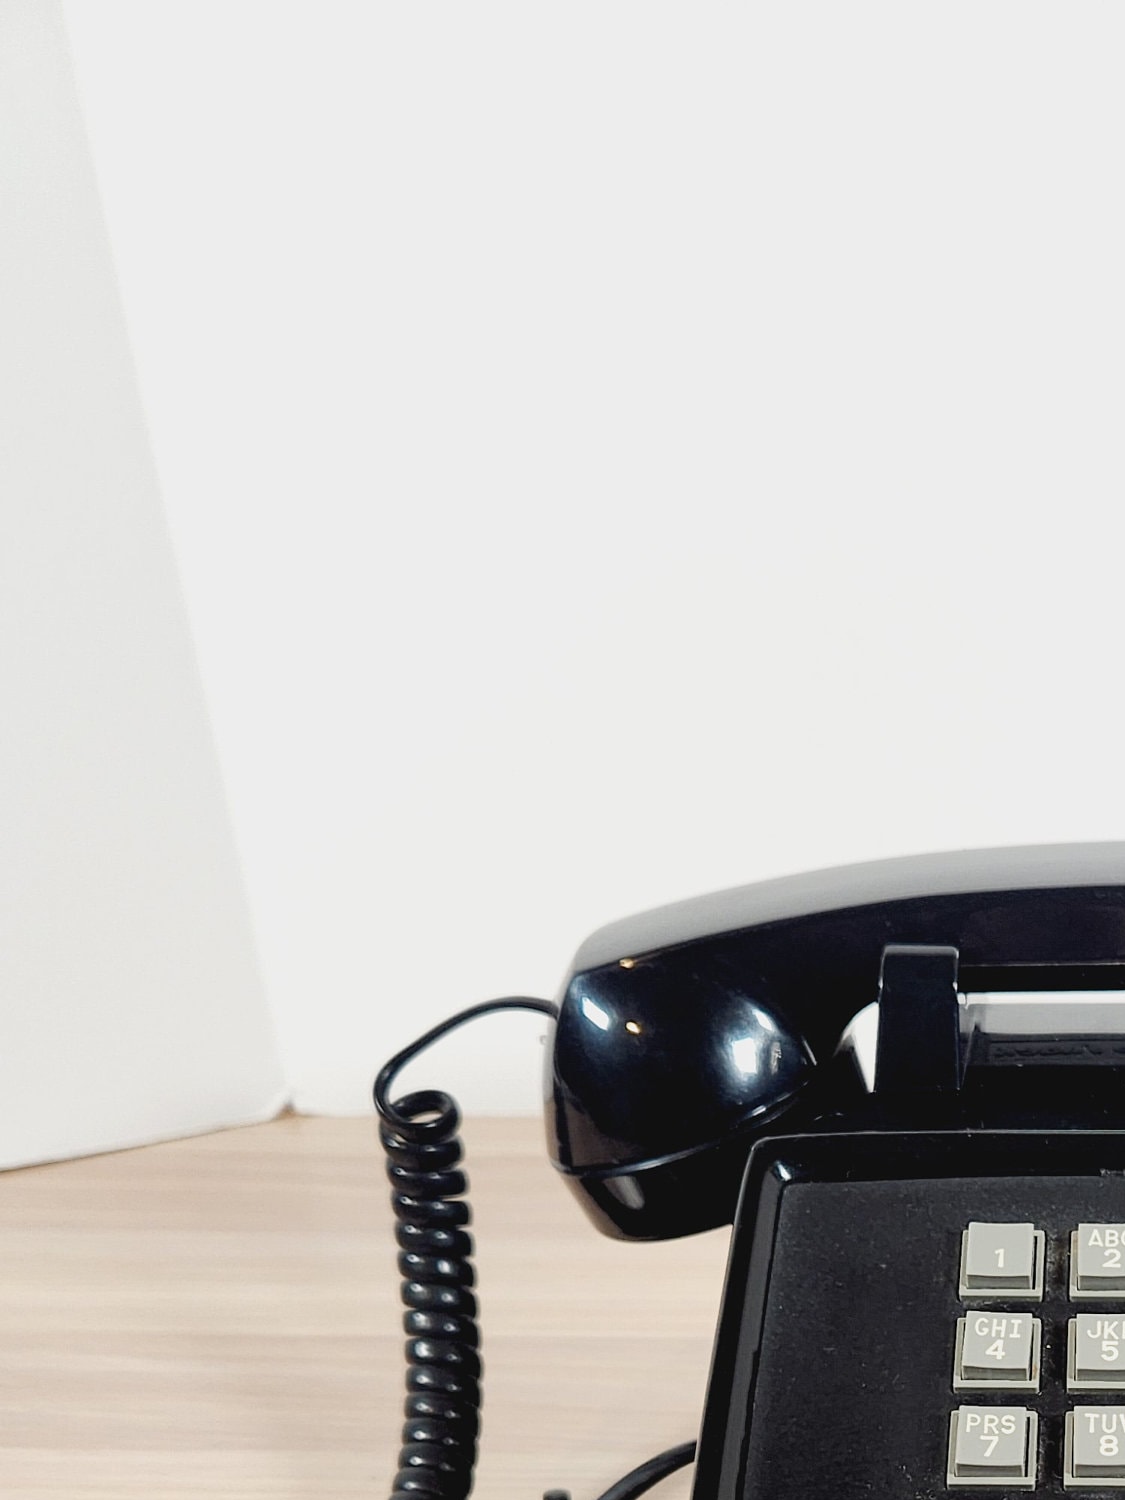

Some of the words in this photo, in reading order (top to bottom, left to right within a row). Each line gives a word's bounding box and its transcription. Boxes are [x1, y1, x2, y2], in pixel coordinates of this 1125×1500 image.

[994, 1248, 1005, 1268] 1
[1102, 1248, 1122, 1268] 2
[974, 1317, 1022, 1338] GHI
[985, 1339, 1006, 1360] 4
[1101, 1340, 1119, 1362] 5
[965, 1413, 1016, 1435] PRS
[979, 1435, 999, 1457] 7
[1099, 1434, 1119, 1457] 8
